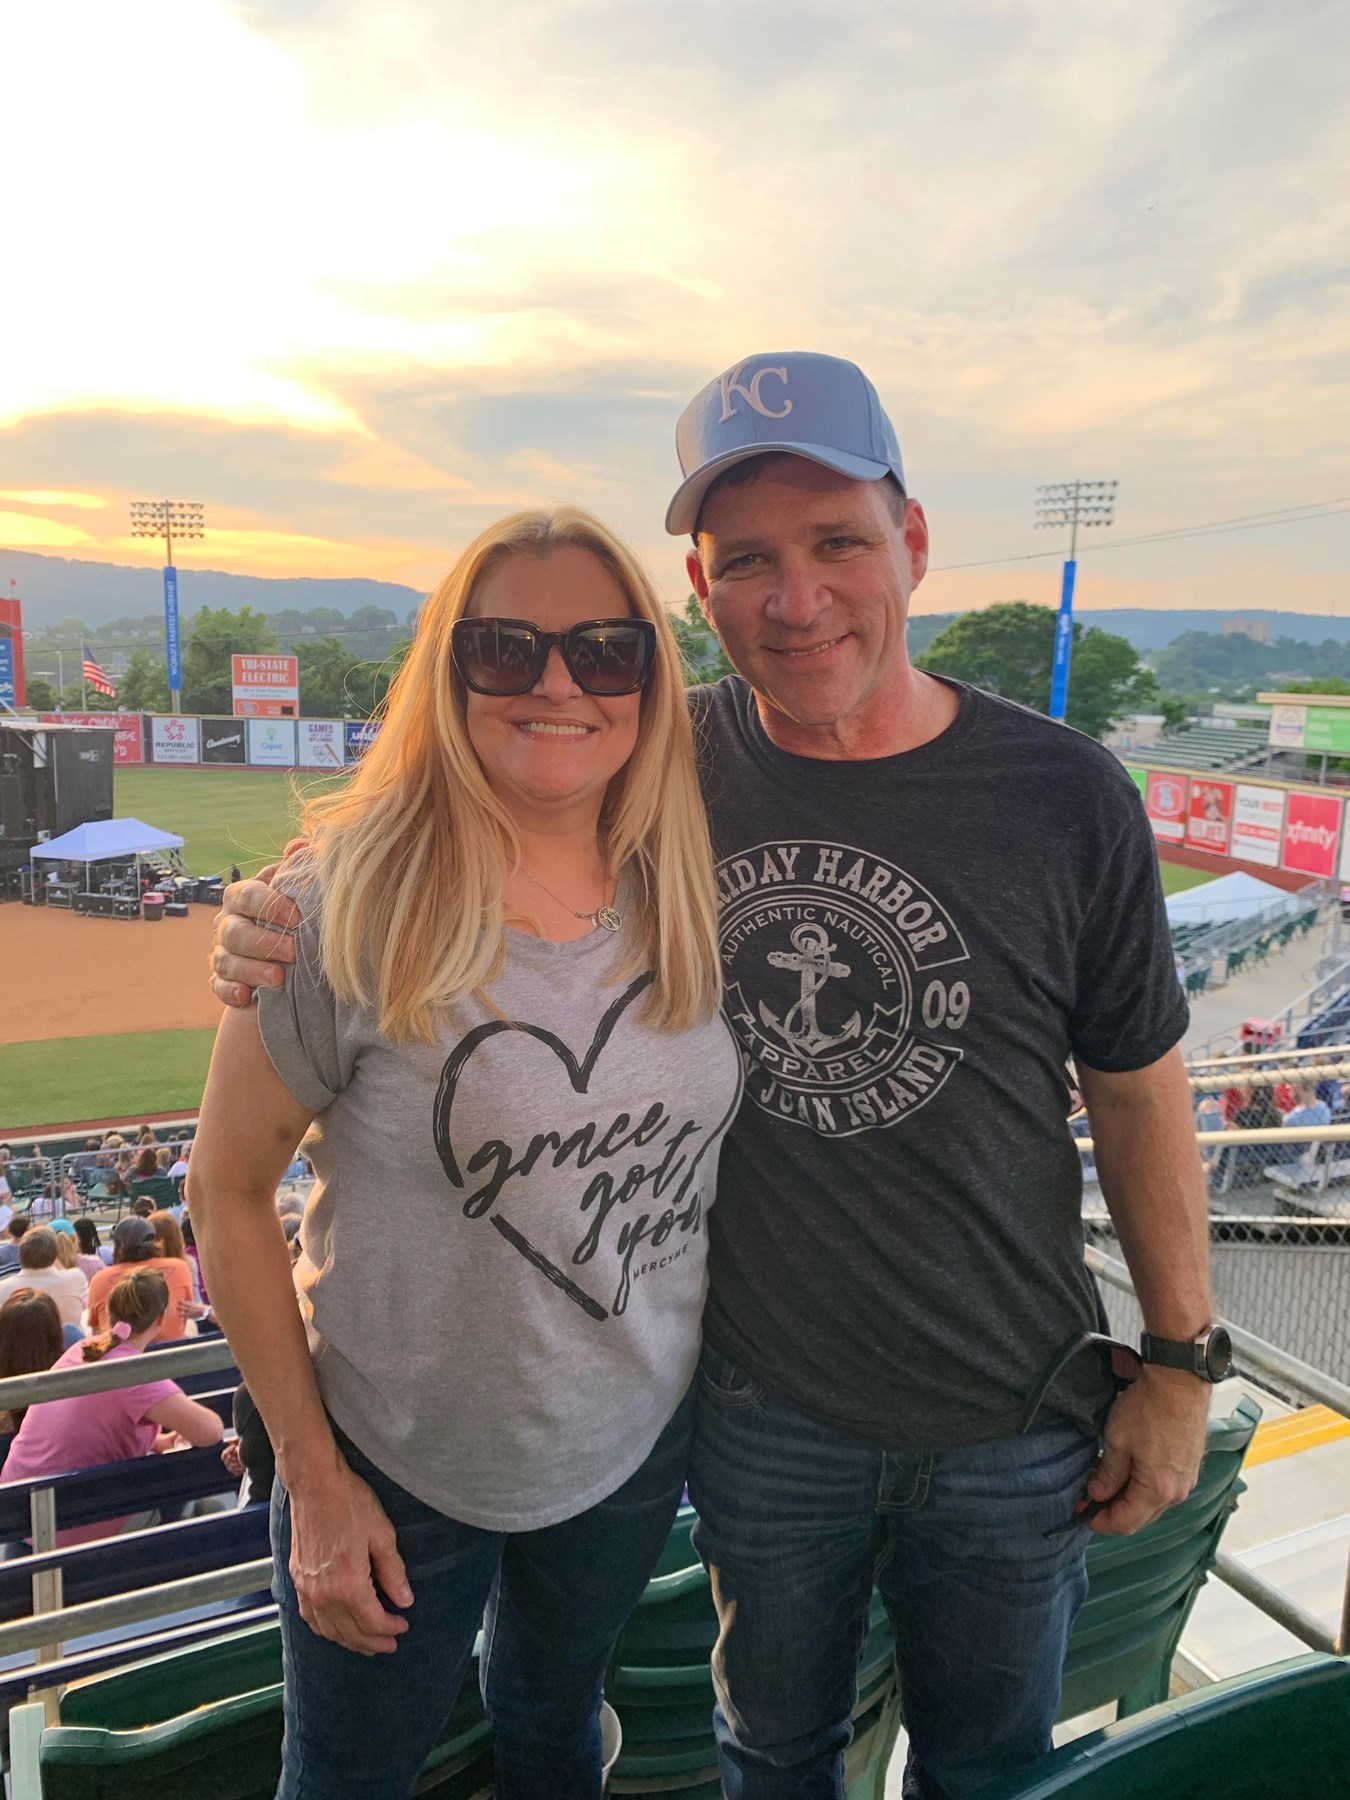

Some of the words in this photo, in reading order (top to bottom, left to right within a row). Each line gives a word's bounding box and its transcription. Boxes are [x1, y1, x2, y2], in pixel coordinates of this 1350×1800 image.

[719, 361, 793, 424] KC
[167, 580, 175, 613] INTERNET
[168, 615, 177, 641] FASTEST
[169, 643, 178, 675] WORLD'S
[241, 658, 289, 671] TRI-STATE
[242, 671, 289, 683] ELECTRIC
[261, 742, 283, 750] Cigna
[1286, 820, 1337, 851] xfinity
[813, 848, 948, 952] HARBOR
[722, 906, 816, 966] AUTHENTIC
[824, 911, 896, 991] NAUTICAL
[922, 980, 970, 1030] 09
[743, 1033, 887, 1082] APPAREL
[841, 1045, 946, 1127] ISLAND
[462, 1101, 671, 1219] grace
[572, 1119, 702, 1265] got
